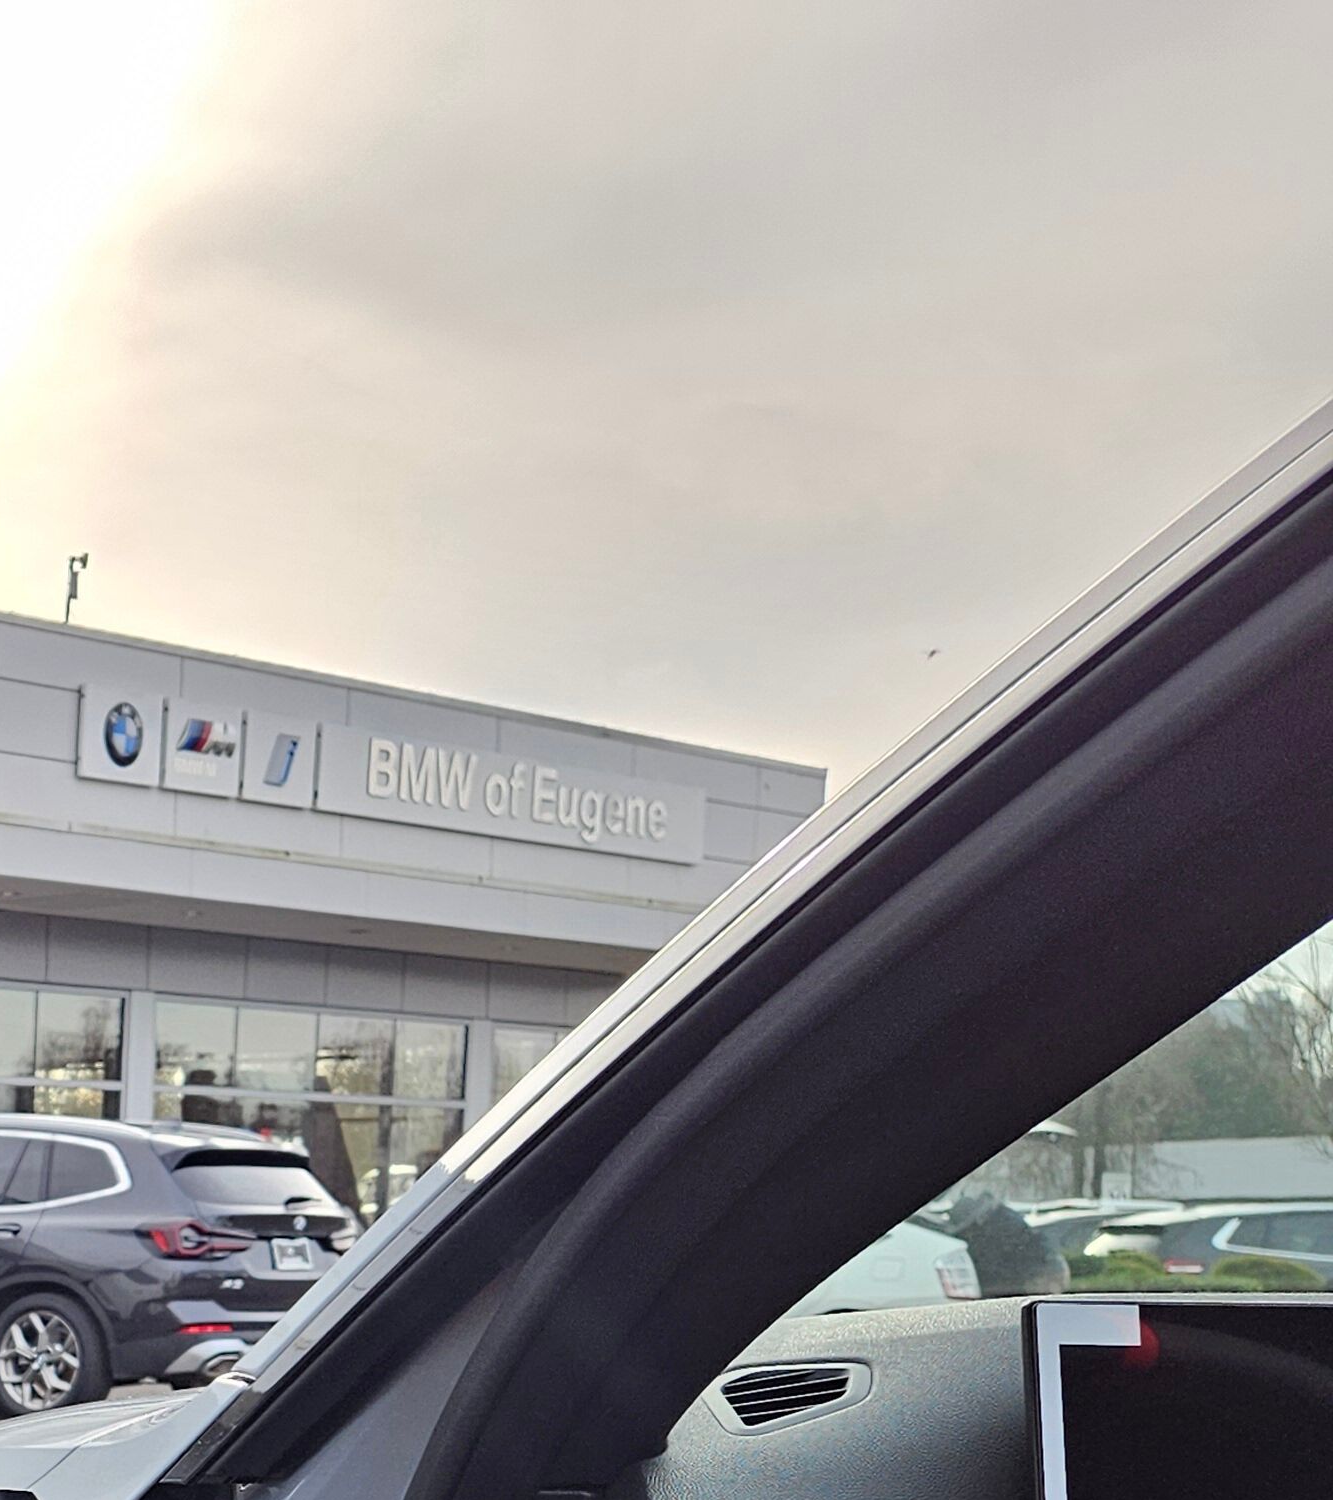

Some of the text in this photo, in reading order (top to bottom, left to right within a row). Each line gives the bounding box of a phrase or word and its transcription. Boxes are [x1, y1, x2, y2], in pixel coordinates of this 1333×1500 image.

[367, 737, 669, 843] BMW of Eugene
